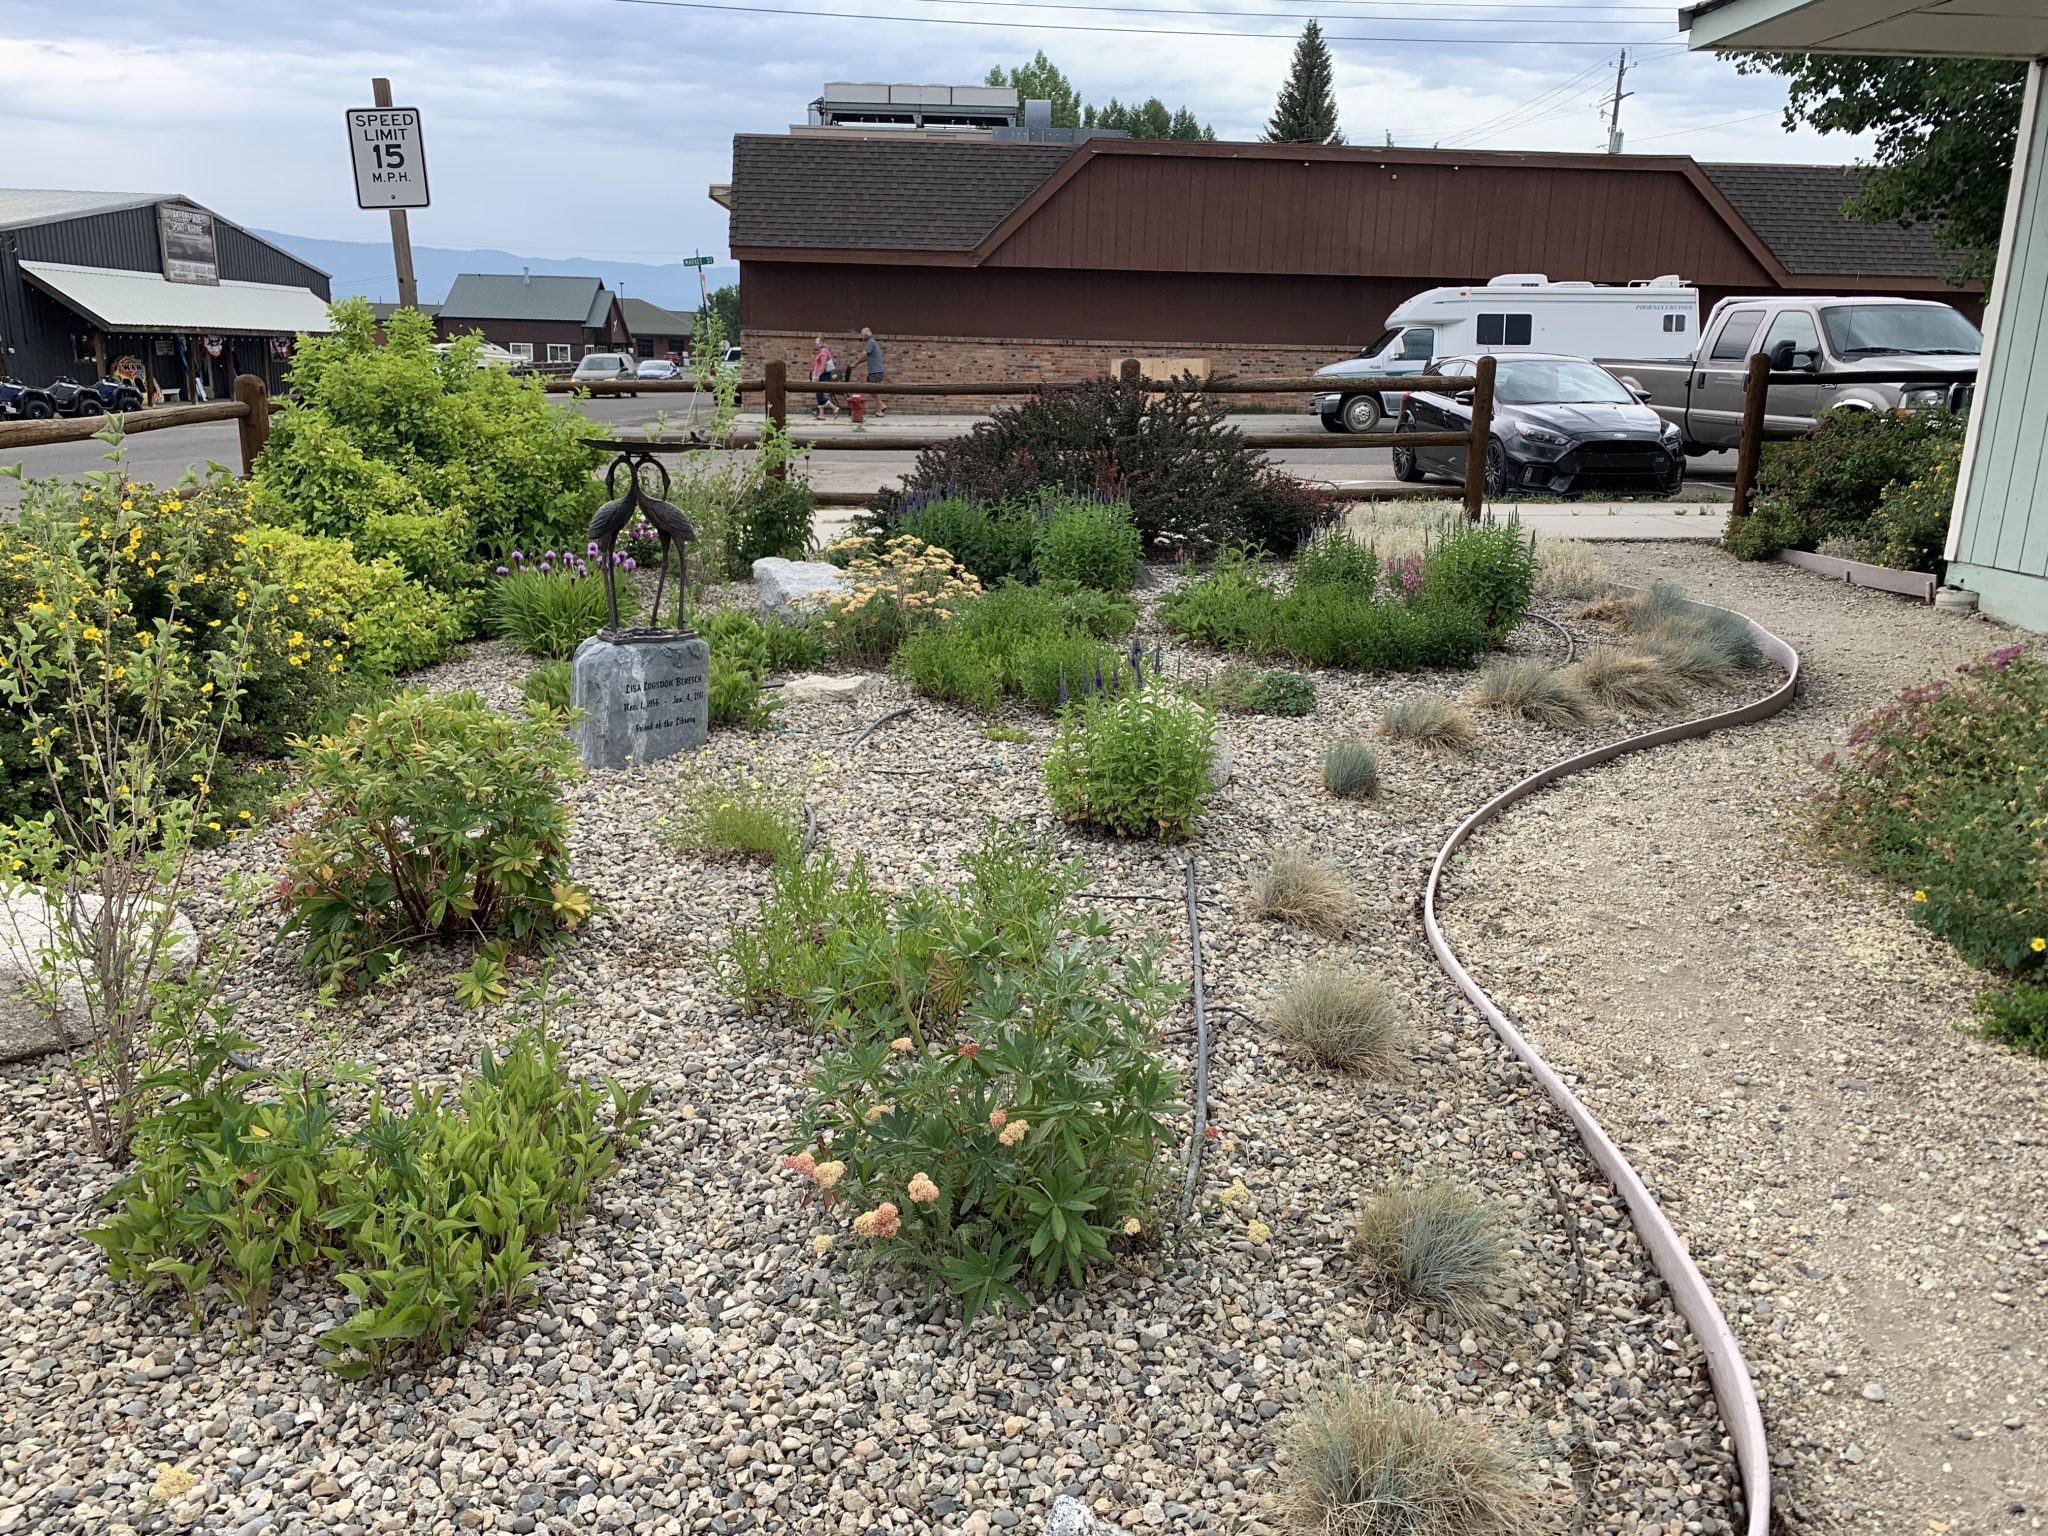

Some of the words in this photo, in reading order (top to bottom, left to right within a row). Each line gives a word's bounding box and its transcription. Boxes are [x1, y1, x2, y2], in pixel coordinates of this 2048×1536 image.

[355, 113, 414, 127] SPEED
[364, 128, 408, 142] LIMIT
[372, 143, 405, 169] 15
[372, 171, 412, 183] M.P.H.
[625, 684, 641, 694] LISA
[635, 721, 654, 733] Friend
[655, 719, 662, 730] of
[664, 719, 674, 728] the
[675, 716, 696, 726] Library
